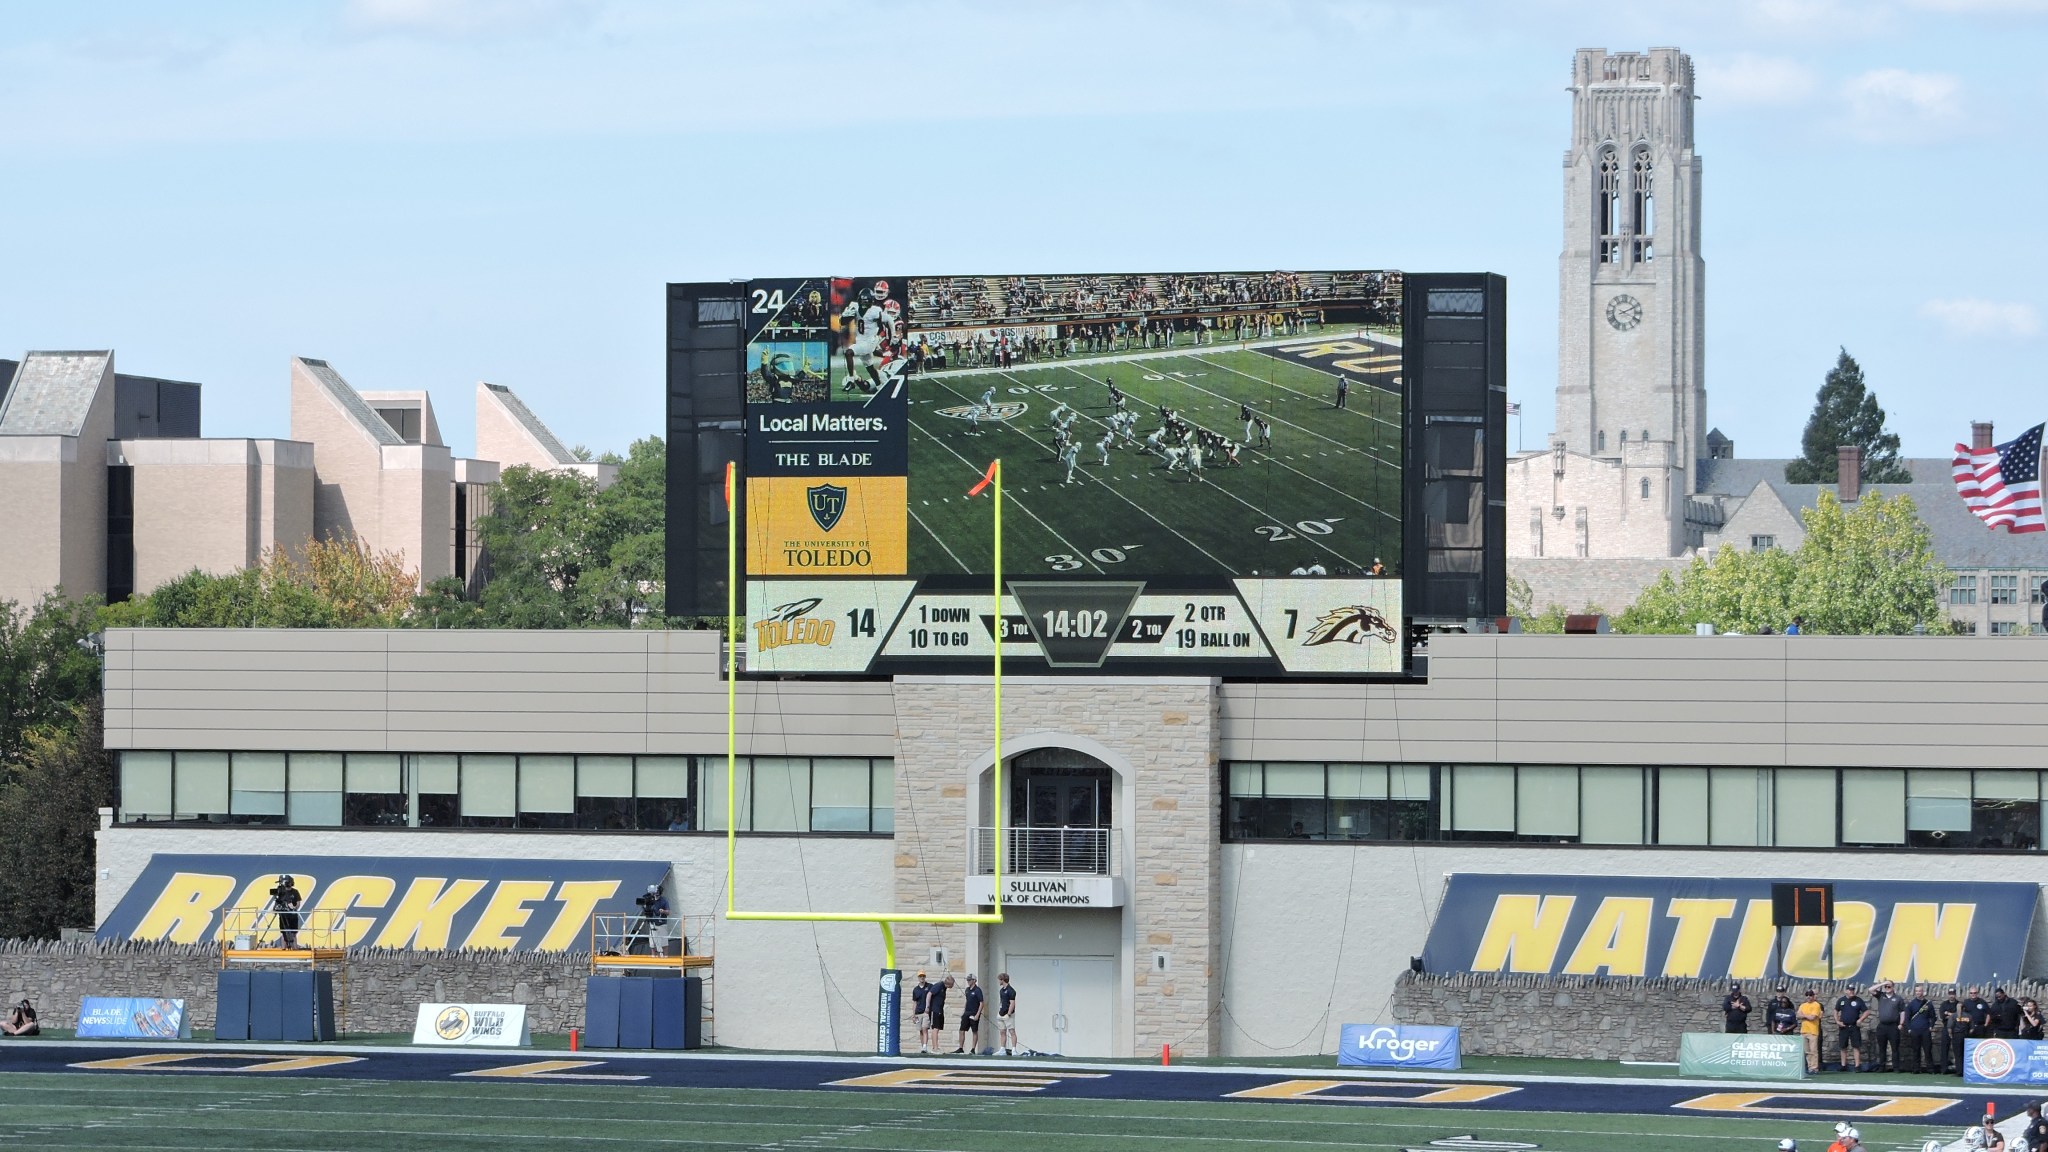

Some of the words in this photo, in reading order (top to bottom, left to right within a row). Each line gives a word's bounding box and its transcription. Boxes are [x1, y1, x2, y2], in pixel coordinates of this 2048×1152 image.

[752, 289, 786, 314] 24
[889, 375, 905, 398] 7
[759, 414, 808, 432] Local
[812, 414, 887, 432] Matters.
[776, 453, 810, 466] THE
[818, 453, 872, 466] BLADE
[813, 494, 839, 514] UT
[1254, 520, 1334, 542] 20
[783, 549, 871, 567] TOLEDO
[1044, 547, 1127, 571] 30
[919, 605, 927, 623] 1
[932, 608, 970, 623] DOWN
[1185, 603, 1195, 622] 2
[1201, 605, 1225, 621] QTR
[847, 608, 876, 637] 14
[1000, 619, 1009, 638] 3
[1012, 623, 1029, 635] TOL
[1043, 610, 1108, 638] 14:02
[1132, 620, 1143, 639] 2
[1146, 624, 1163, 636] TOL
[1284, 609, 1298, 639] 7
[753, 618, 836, 652] TOLEDO
[908, 629, 928, 648] 10
[933, 632, 948, 646] TO
[952, 632, 969, 646] GO
[1175, 629, 1196, 648] 19
[1200, 632, 1230, 648] BALL
[1233, 632, 1250, 647] ON
[1011, 881, 1067, 893] SULLIVAN
[1017, 894, 1030, 903] OF
[1033, 894, 1090, 904] CHAMPIONS
[1794, 887, 1826, 924] 17
[130, 873, 622, 952] ROCKET
[1470, 893, 1976, 984] NATION
[473, 1017, 504, 1027] WILD
[474, 1010, 506, 1018] BUFFALO
[472, 1026, 502, 1036] WINGS
[1358, 1027, 1440, 1061] Kroger
[1731, 1042, 1768, 1051] GLASS
[1769, 1043, 1797, 1052] CITY
[1730, 1059, 1759, 1067] CREDIT
[1731, 1050, 1783, 1060] FEDERAL
